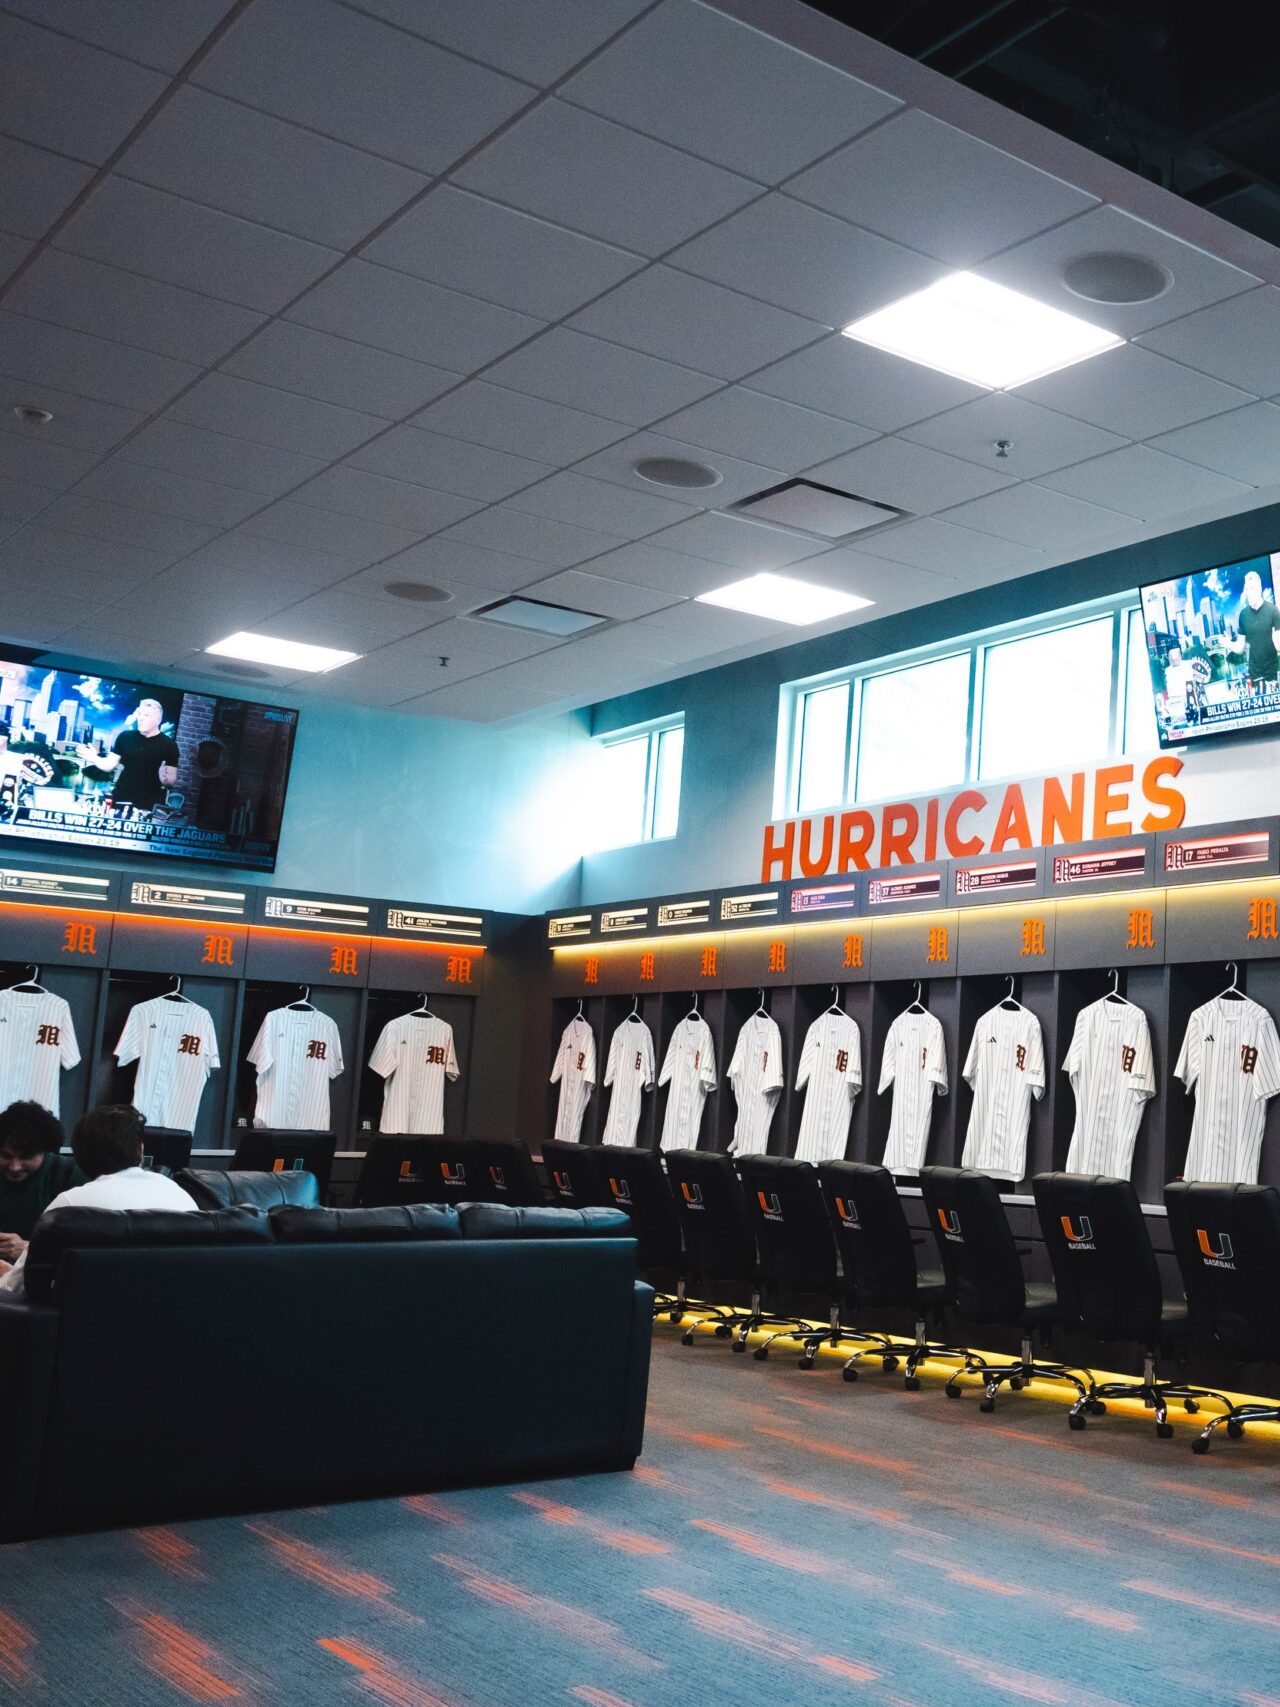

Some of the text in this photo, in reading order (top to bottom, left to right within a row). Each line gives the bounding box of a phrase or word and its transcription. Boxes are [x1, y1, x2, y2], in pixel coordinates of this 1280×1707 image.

[1207, 704, 1227, 717] BILLS
[1227, 701, 1242, 714] WIN
[1242, 698, 1263, 712] 27-24
[29, 809, 64, 823] BILLS
[64, 814, 88, 827] WIN
[88, 818, 122, 831] 27-24
[123, 822, 153, 835] OVER
[155, 825, 176, 837] THE
[177, 827, 227, 843] JAGUARS
[761, 757, 1186, 883] HURRICANES
[1185, 850, 1193, 860] 17
[1071, 864, 1081, 875] 46
[971, 876, 980, 885] 28
[440, 1163, 465, 1180] U
[609, 1178, 630, 1198] U
[681, 1183, 703, 1203] U
[757, 1191, 781, 1214] U
[835, 1197, 858, 1221] U
[937, 1208, 961, 1233] U
[1061, 1216, 1093, 1241] U
[1197, 1229, 1234, 1260] U
[1203, 1258, 1236, 1270] BASEBALL
